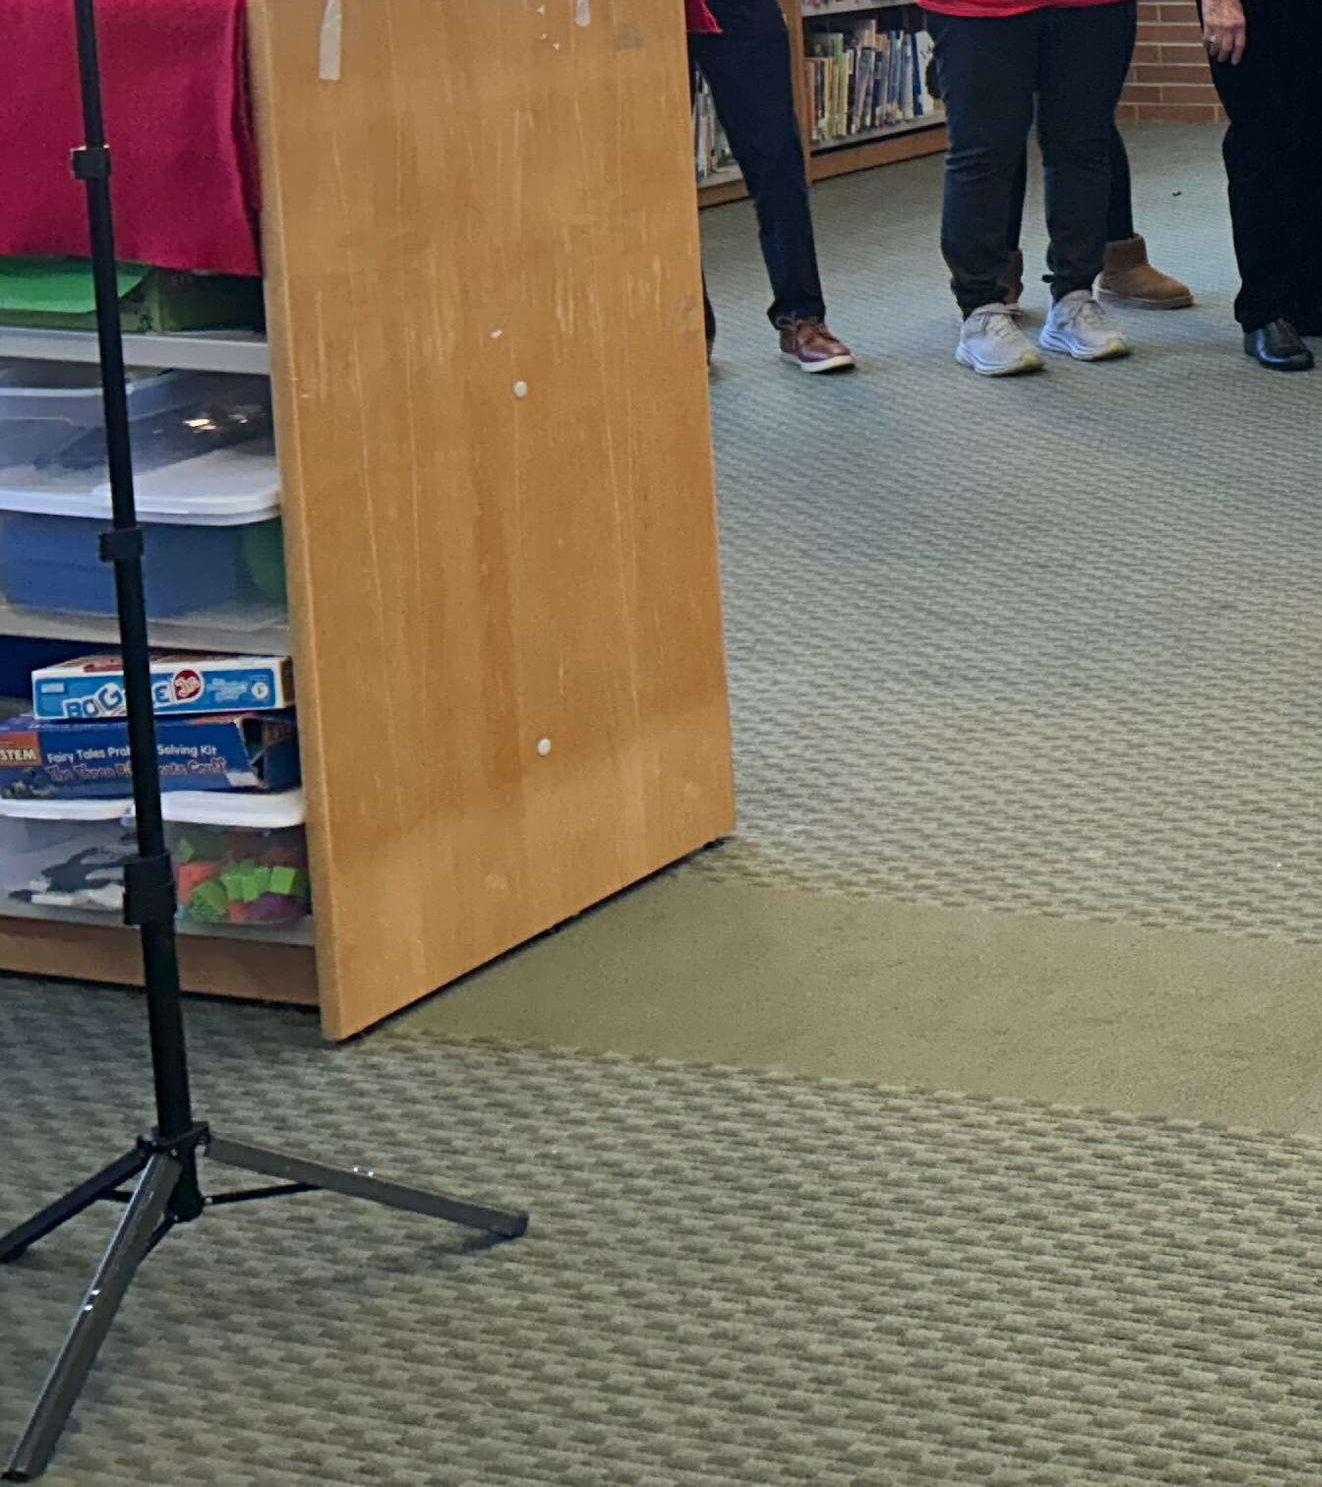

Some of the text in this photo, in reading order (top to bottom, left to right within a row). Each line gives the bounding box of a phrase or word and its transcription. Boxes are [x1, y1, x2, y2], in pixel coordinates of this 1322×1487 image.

[64, 683, 172, 718] BOGE
[47, 752, 74, 764] Fairy
[76, 749, 106, 760] Tales
[157, 744, 198, 757] Solving
[201, 744, 217, 755] Kit
